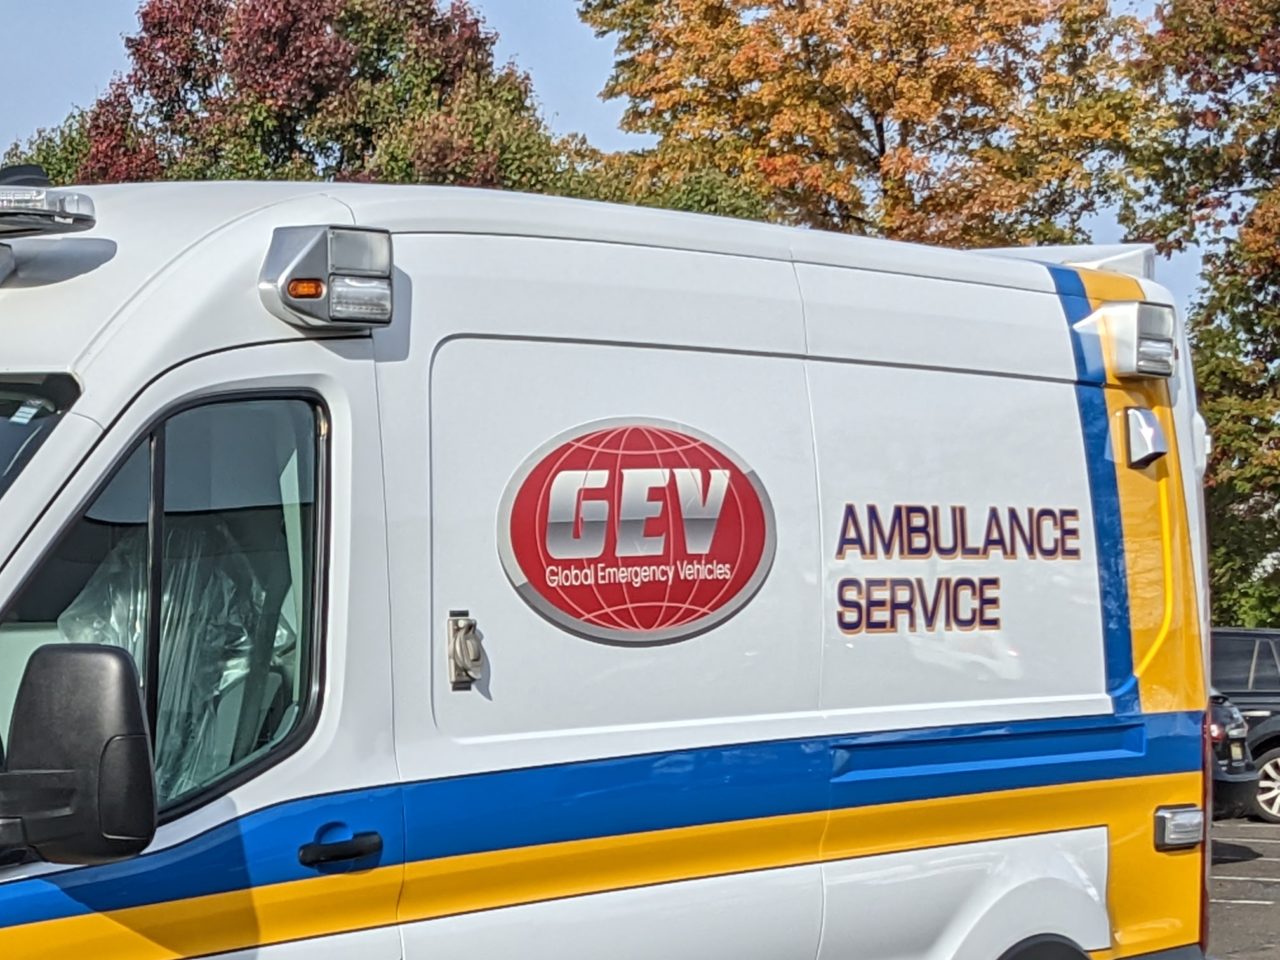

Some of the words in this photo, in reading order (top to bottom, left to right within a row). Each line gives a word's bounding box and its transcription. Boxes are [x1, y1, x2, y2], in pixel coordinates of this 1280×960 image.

[546, 468, 731, 560] GEV
[835, 503, 1081, 561] AMBULANCE
[545, 564, 595, 588] Global
[597, 562, 675, 589] Emergency
[676, 559, 731, 581] Vehicles
[836, 576, 1002, 635] SERVICE
